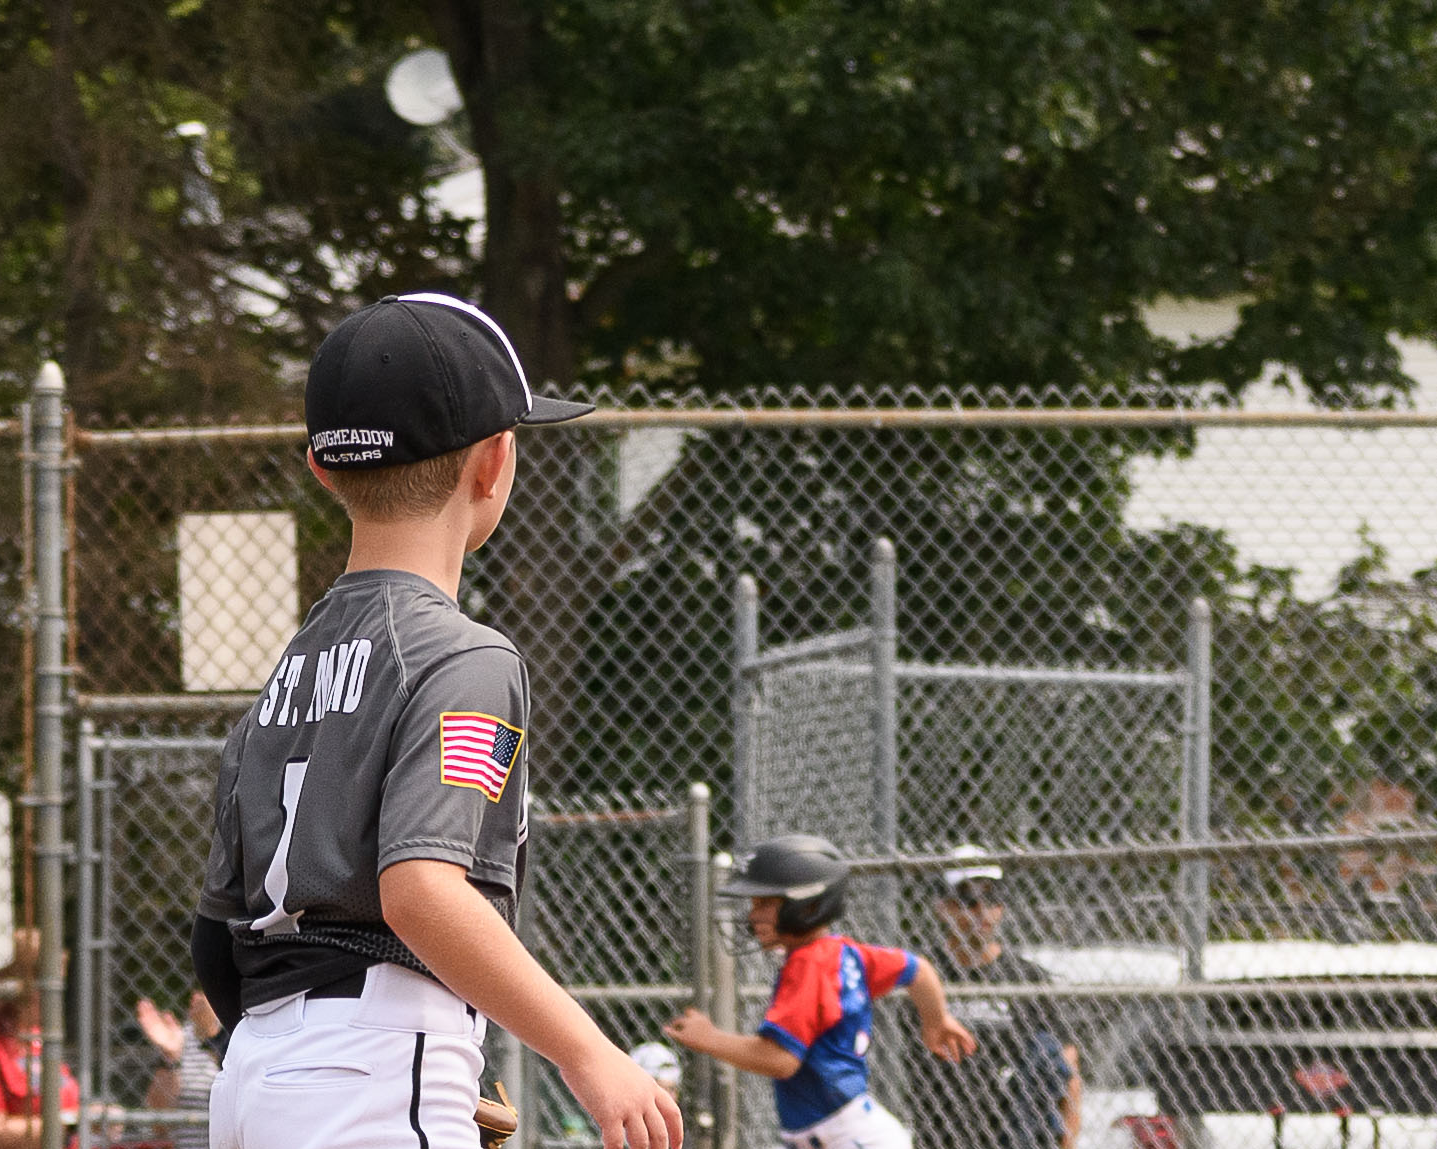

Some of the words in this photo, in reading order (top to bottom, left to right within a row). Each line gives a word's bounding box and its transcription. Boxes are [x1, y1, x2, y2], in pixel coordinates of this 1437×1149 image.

[312, 429, 394, 452] LONGMEADOW
[323, 449, 382, 462] ALL-STARS
[258, 653, 306, 727] ST.
